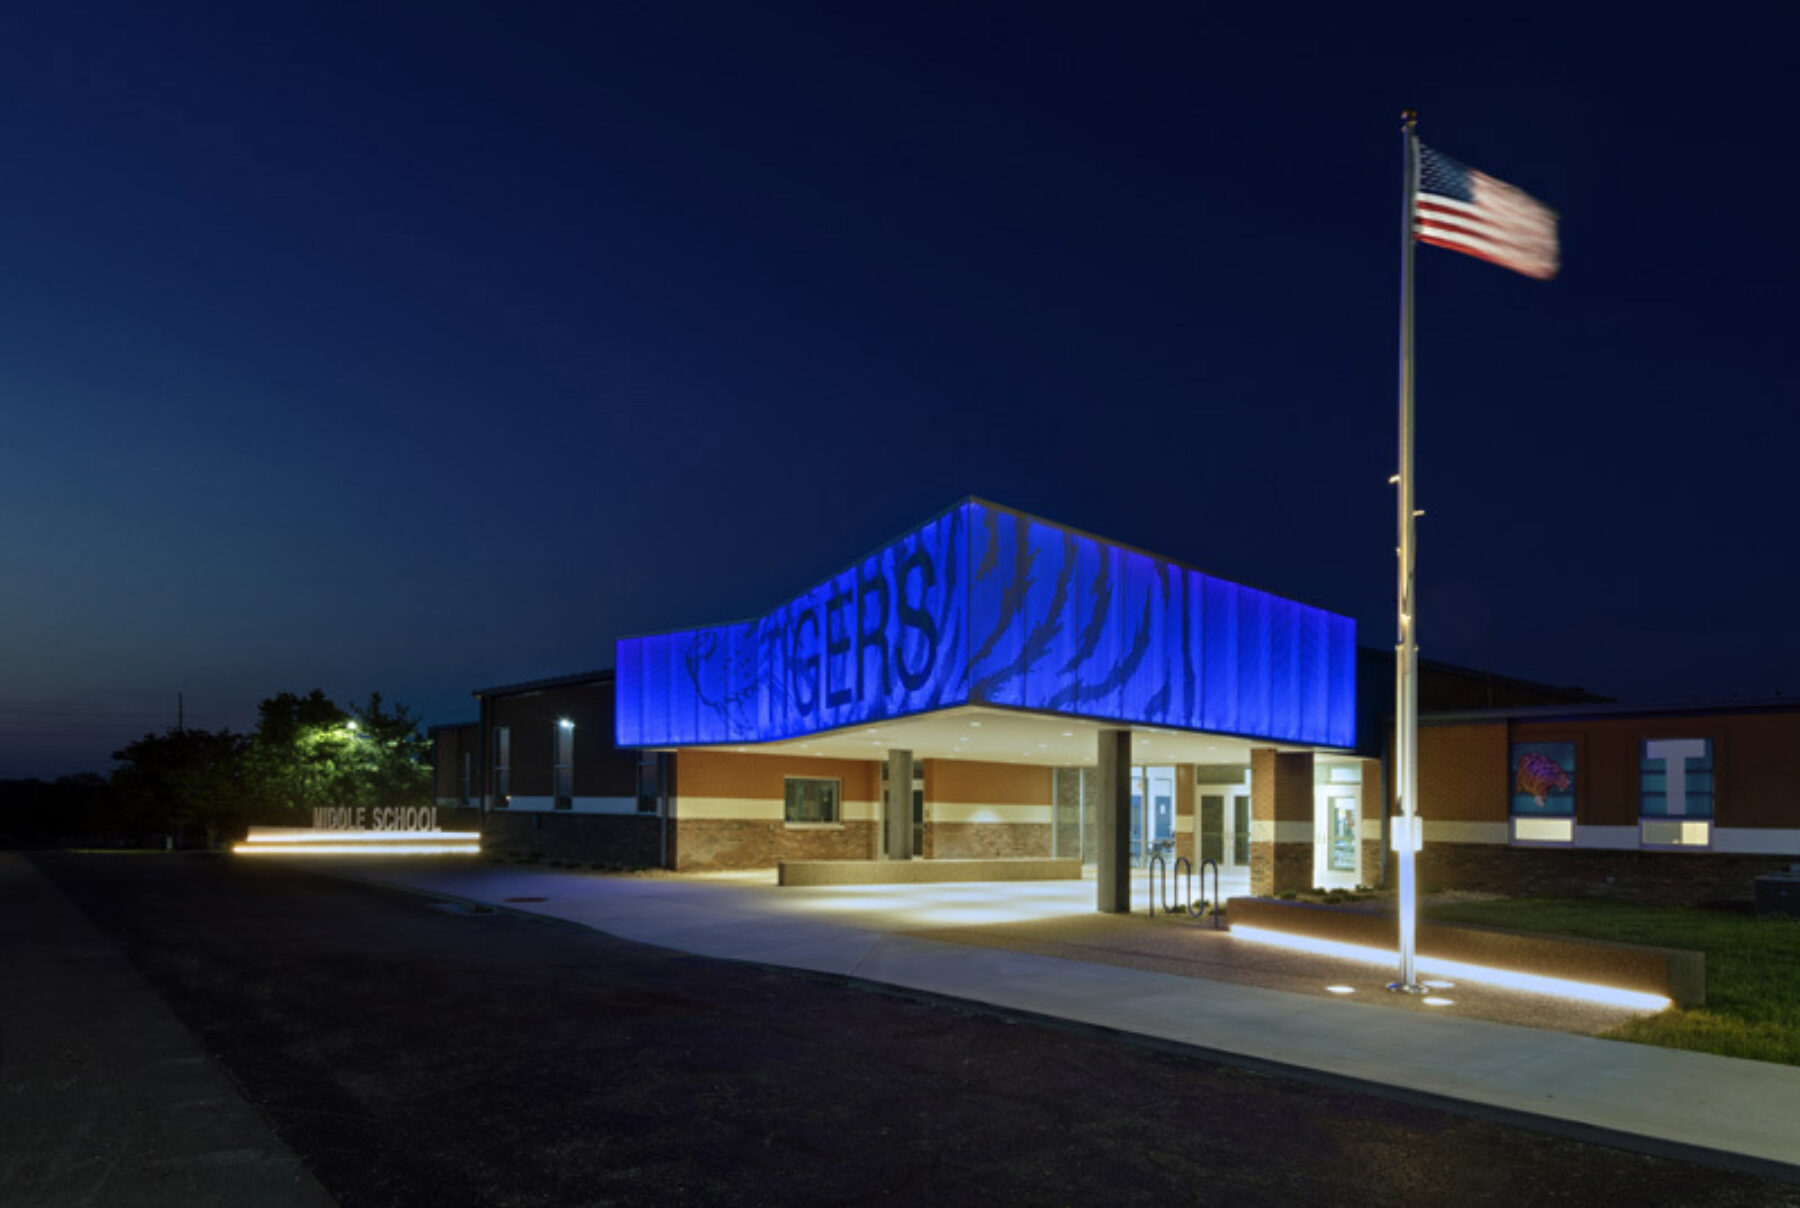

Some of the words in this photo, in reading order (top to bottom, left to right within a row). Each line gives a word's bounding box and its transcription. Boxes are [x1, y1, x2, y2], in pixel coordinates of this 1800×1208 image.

[760, 550, 937, 722] TIGERS
[313, 806, 366, 831] MIDDLE
[372, 806, 442, 832] SCHOOL
